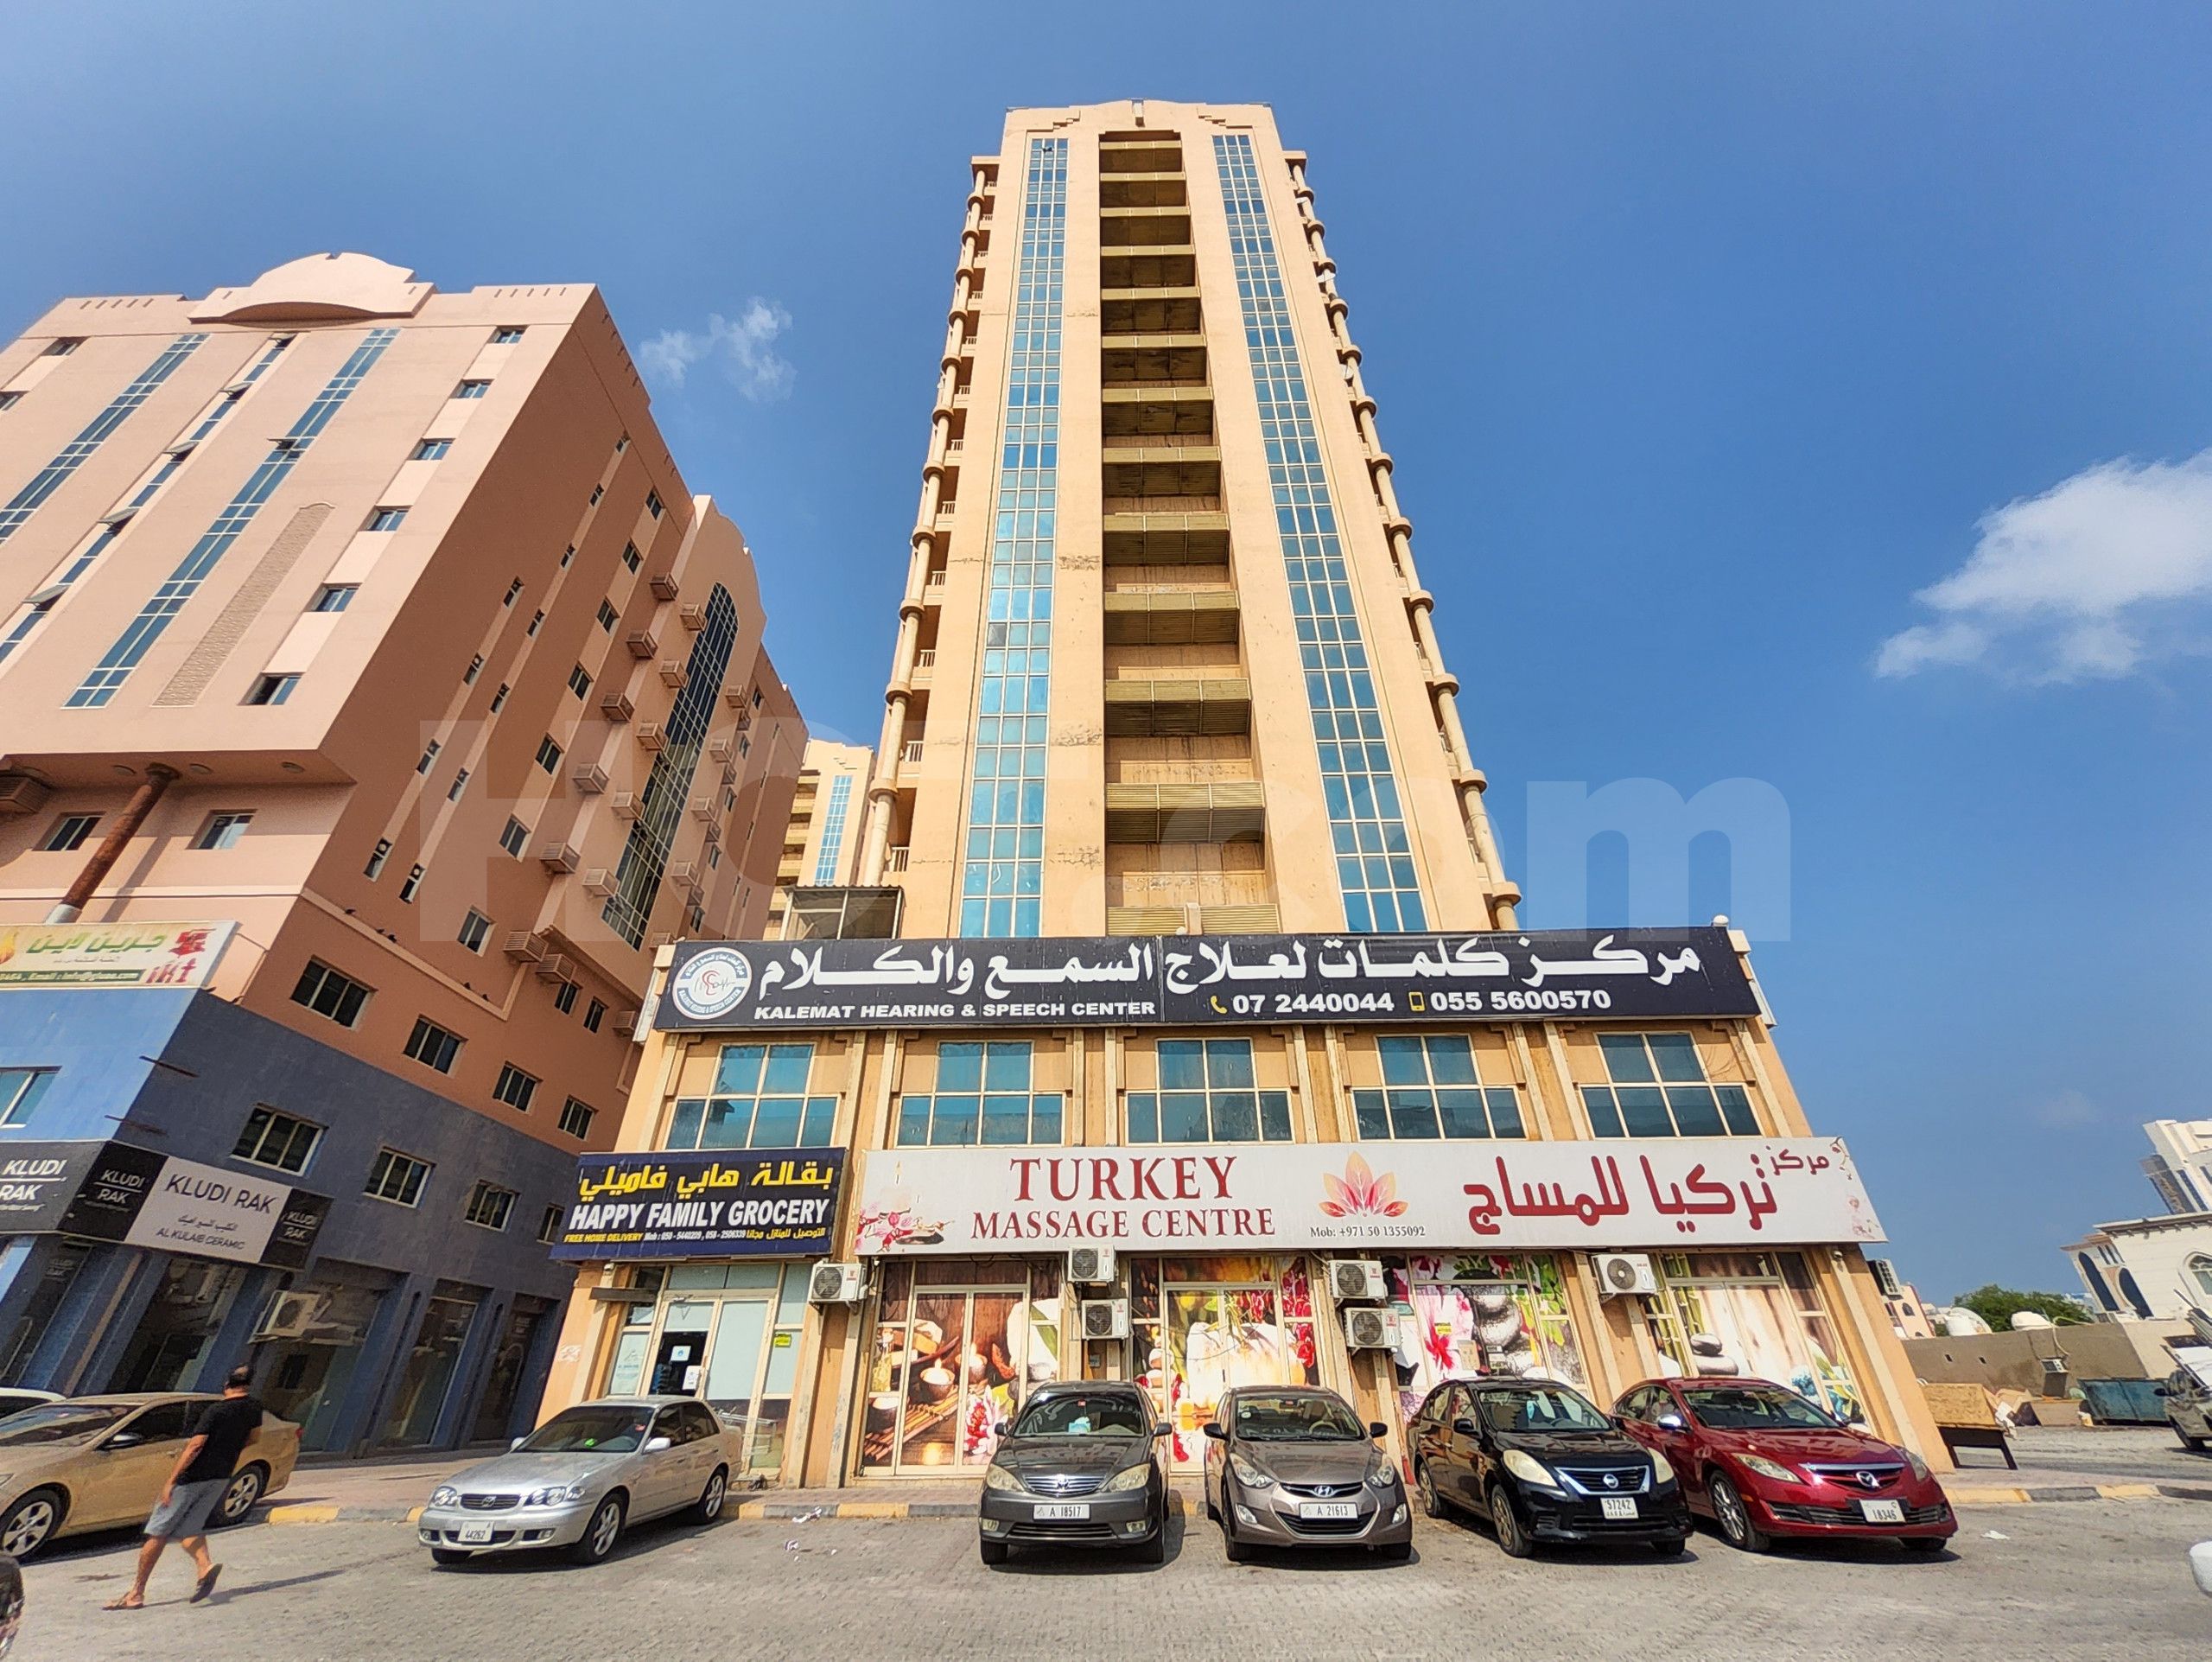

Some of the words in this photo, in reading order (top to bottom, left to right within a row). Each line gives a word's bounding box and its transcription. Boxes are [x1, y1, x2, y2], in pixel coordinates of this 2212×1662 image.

[86, 932, 168, 953] جرين
[1318, 935, 1510, 978] كلمات
[760, 944, 976, 1001] والكلام
[984, 942, 1153, 1000] السمع
[1164, 940, 1307, 995] لعلاج
[1520, 934, 1702, 987] مركز
[754, 1005, 855, 1020] KALEMAT
[861, 1003, 954, 1018] HEARING
[961, 1003, 976, 1017] &
[982, 1003, 1065, 1017] SPEECH
[1071, 1001, 1155, 1016] CENTER
[1233, 993, 1262, 1014] 07
[1274, 991, 1395, 1013] 2440044
[1430, 991, 1483, 1011] 055
[1491, 990, 1611, 1011] 5600570
[2, 1159, 67, 1175] KLUDI
[1764, 1144, 1831, 1176] مركز
[100, 1169, 145, 1188] KLUDI
[580, 1163, 668, 1202] فاميلي
[677, 1163, 740, 1200] هابي
[751, 1161, 835, 1191] بقالة
[1008, 1156, 1238, 1201] TURKEY
[1638, 1152, 1778, 1231] تركيا
[0, 1185, 42, 1200] RAK
[97, 1188, 130, 1204] RAK
[164, 1174, 232, 1204] KLUDI
[234, 1188, 279, 1214] RAK
[1463, 1154, 1630, 1236] للمساج
[569, 1203, 645, 1231] HAPPY
[645, 1200, 725, 1229] FAMILY
[728, 1198, 830, 1226] GROCERY
[969, 1209, 1130, 1239] MASSAGE
[1141, 1207, 1276, 1237] CENTRE
[156, 1227, 170, 1239] AL
[564, 1233, 583, 1243] FREE
[584, 1232, 607, 1243] HOME
[607, 1232, 643, 1243] DELIVERY
[1310, 1226, 1336, 1238] Mob:
[1339, 1226, 1364, 1238] +971
[1368, 1226, 1380, 1237] 50
[1383, 1226, 1426, 1237] 1355092
[1049, 1506, 1056, 1518] A
[1060, 1506, 1082, 1518] 18517
[1317, 1506, 1323, 1517] A
[1327, 1506, 1348, 1517] 21613
